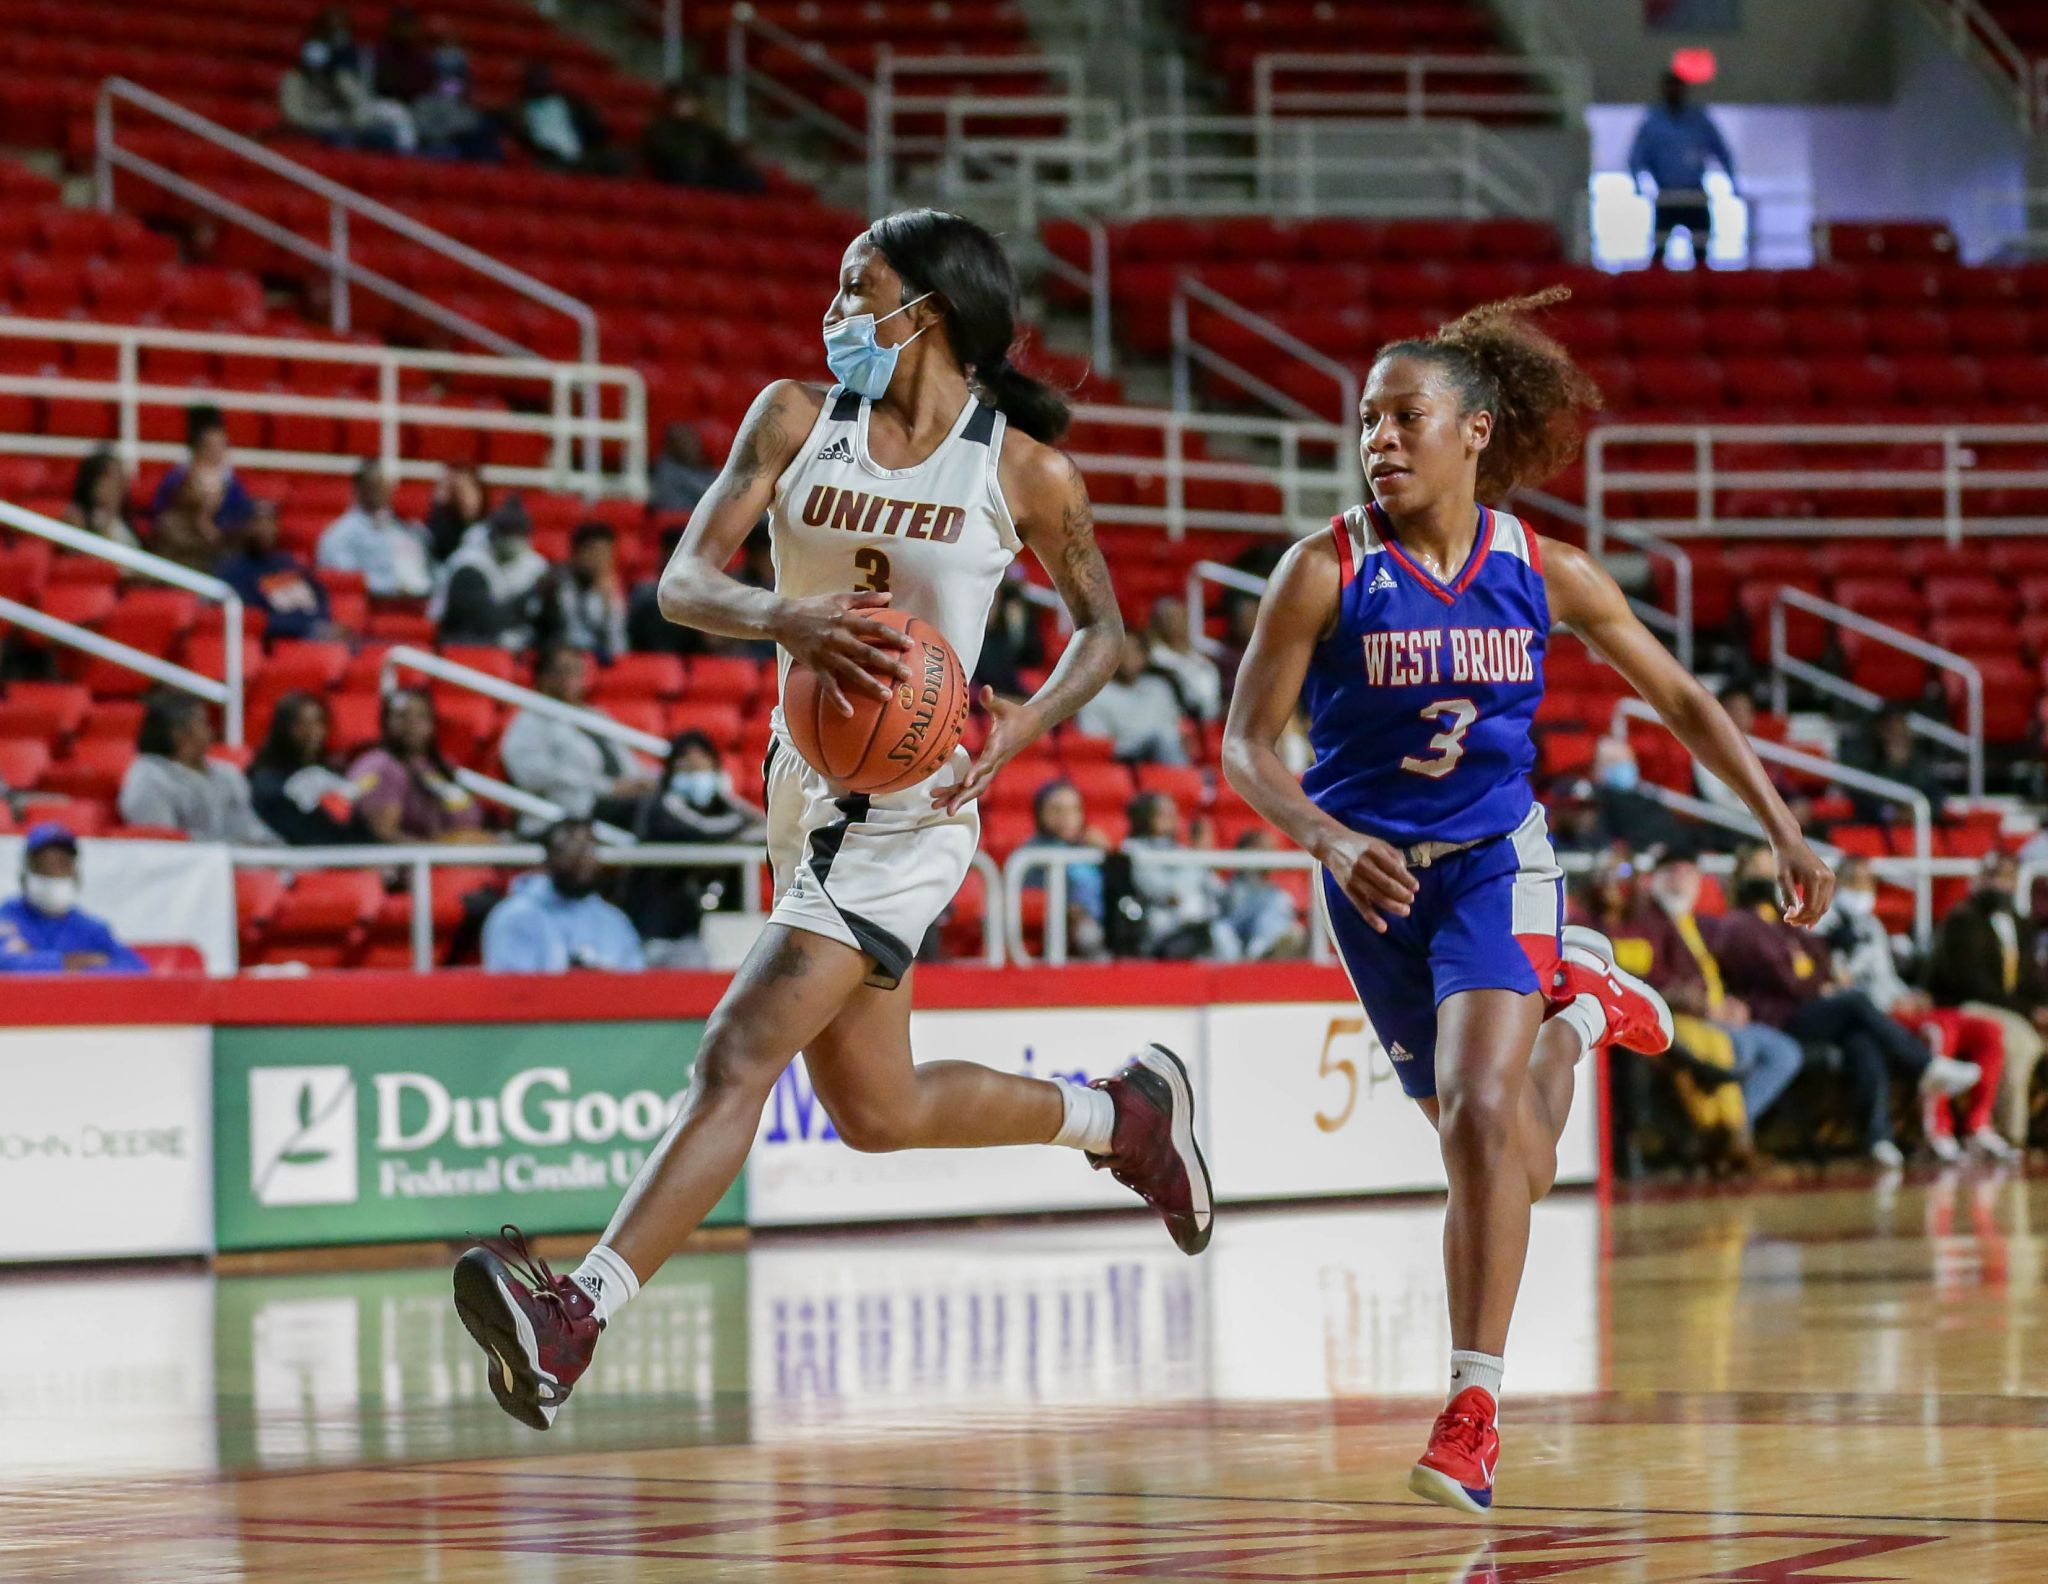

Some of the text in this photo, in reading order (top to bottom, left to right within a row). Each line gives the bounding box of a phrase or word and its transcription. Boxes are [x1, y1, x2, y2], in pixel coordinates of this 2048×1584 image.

[817, 451, 855, 464] adidas
[802, 484, 967, 544] UNITED
[854, 547, 890, 606] 3
[1368, 578, 1398, 594] adidas
[1363, 628, 1534, 686] WEST BROOK
[887, 642, 945, 767] SPALDING
[1401, 698, 1478, 778] 3
[378, 1155, 500, 1199] Federal
[502, 1152, 608, 1194] Credit
[579, 1276, 602, 1302] adidas
